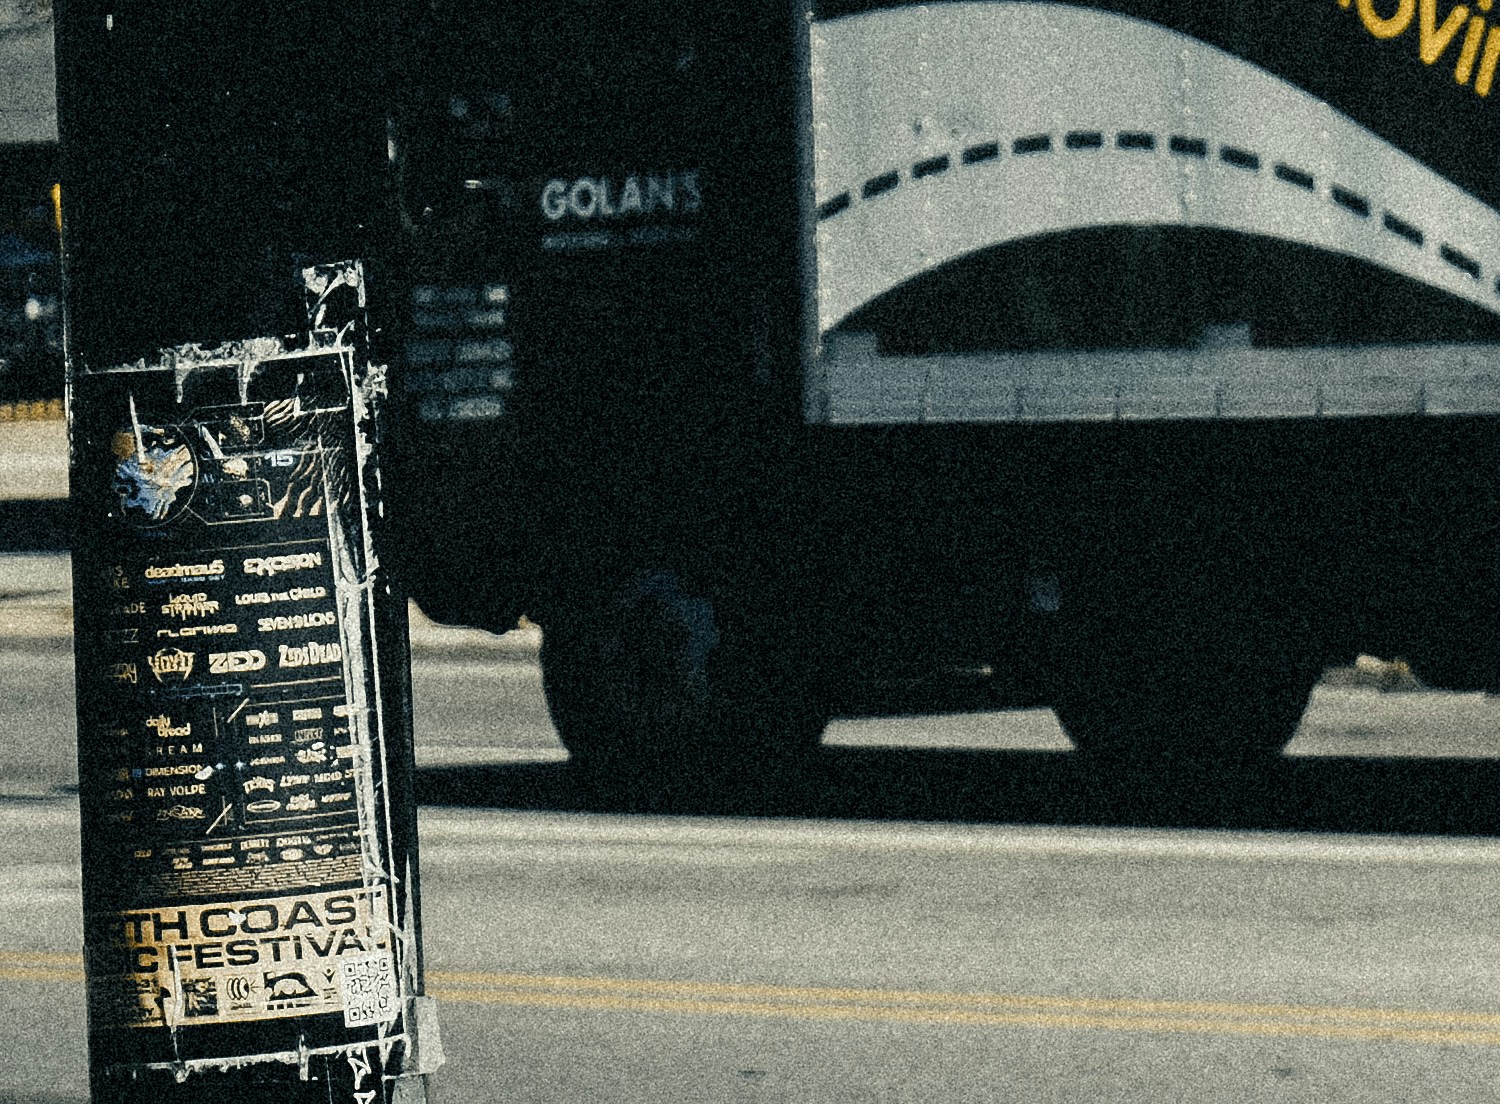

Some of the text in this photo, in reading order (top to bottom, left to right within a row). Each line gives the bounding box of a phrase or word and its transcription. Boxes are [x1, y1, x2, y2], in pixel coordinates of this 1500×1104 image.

[144, 559, 225, 579] deadmau5
[208, 649, 267, 675] ZEDD
[147, 783, 207, 798] RAY VOLPE
[168, 927, 387, 971] FESTIVA
